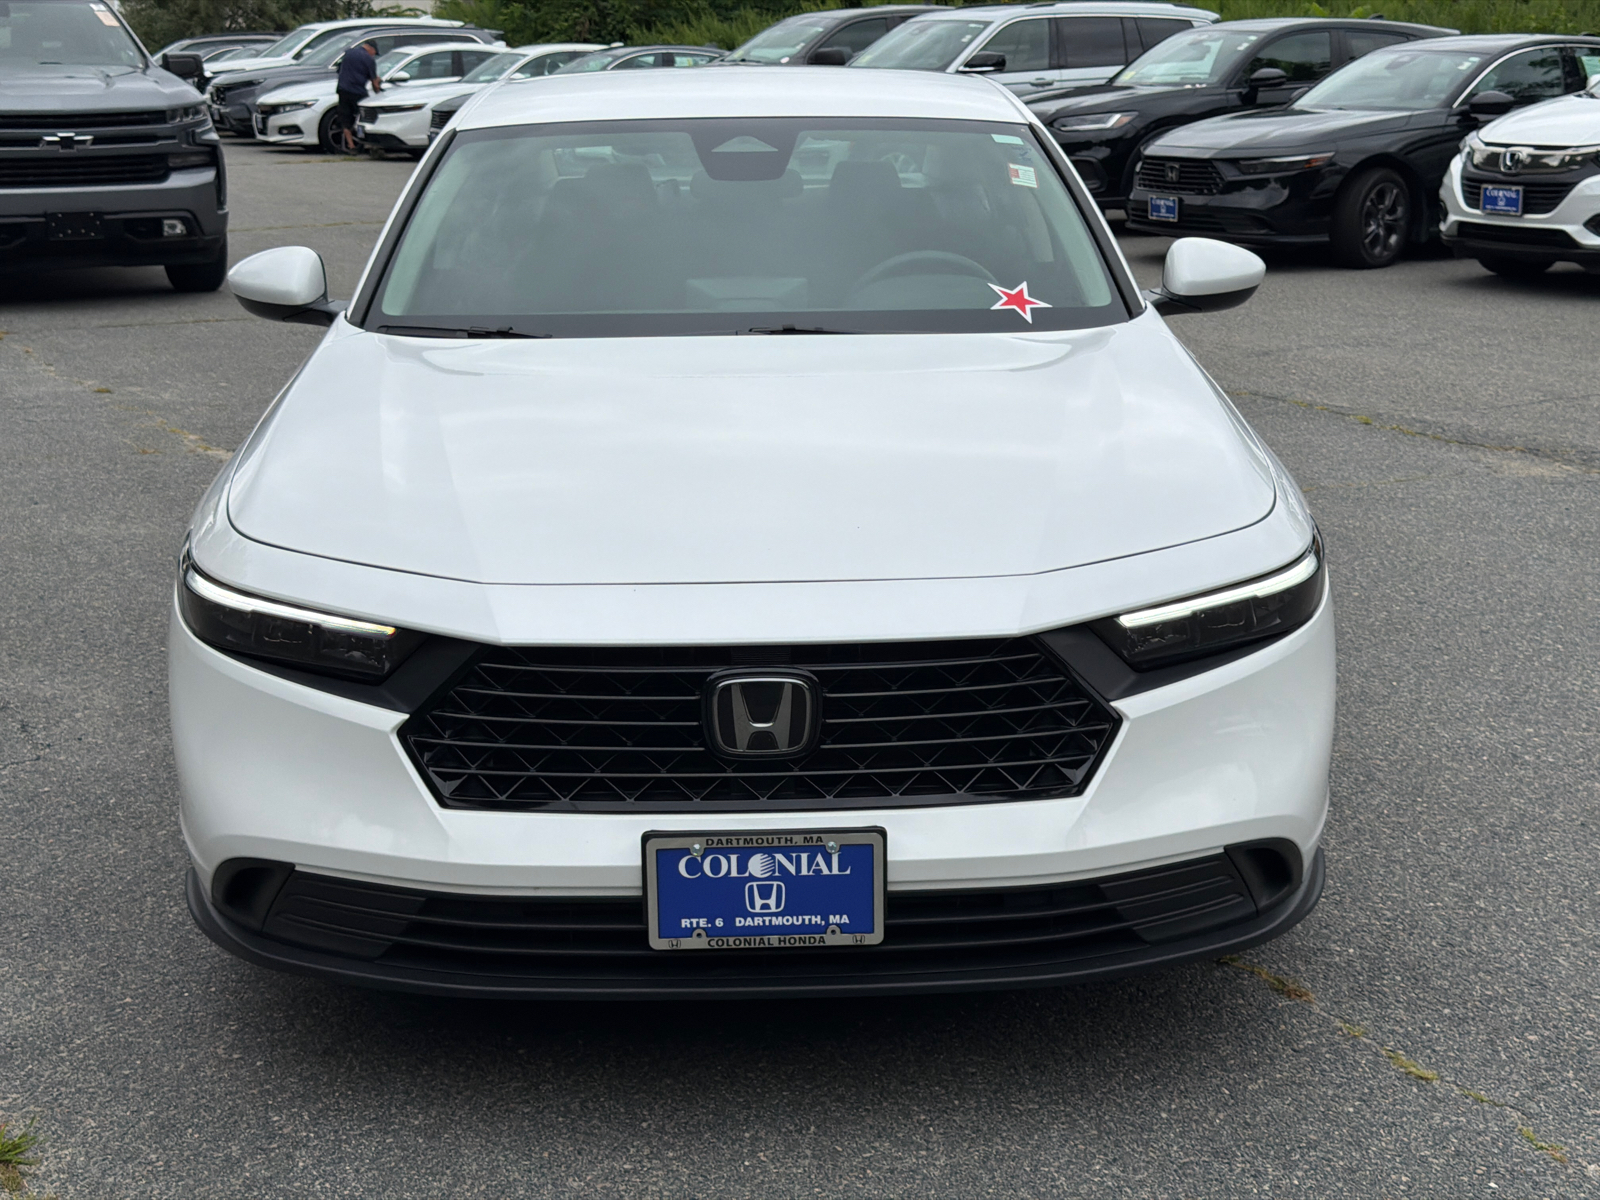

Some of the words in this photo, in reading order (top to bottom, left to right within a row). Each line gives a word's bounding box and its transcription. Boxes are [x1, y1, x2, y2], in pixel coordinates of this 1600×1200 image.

[705, 836, 799, 846] DARTMOUTH,
[803, 836, 824, 844] MA
[678, 852, 851, 878] COLONIAL
[681, 918, 711, 928] RTE.
[715, 917, 724, 927] 6
[735, 915, 826, 927] DARTMOUTH,
[829, 914, 850, 924] MA
[707, 937, 774, 948] COLONIAL
[778, 935, 826, 945] HONDA
